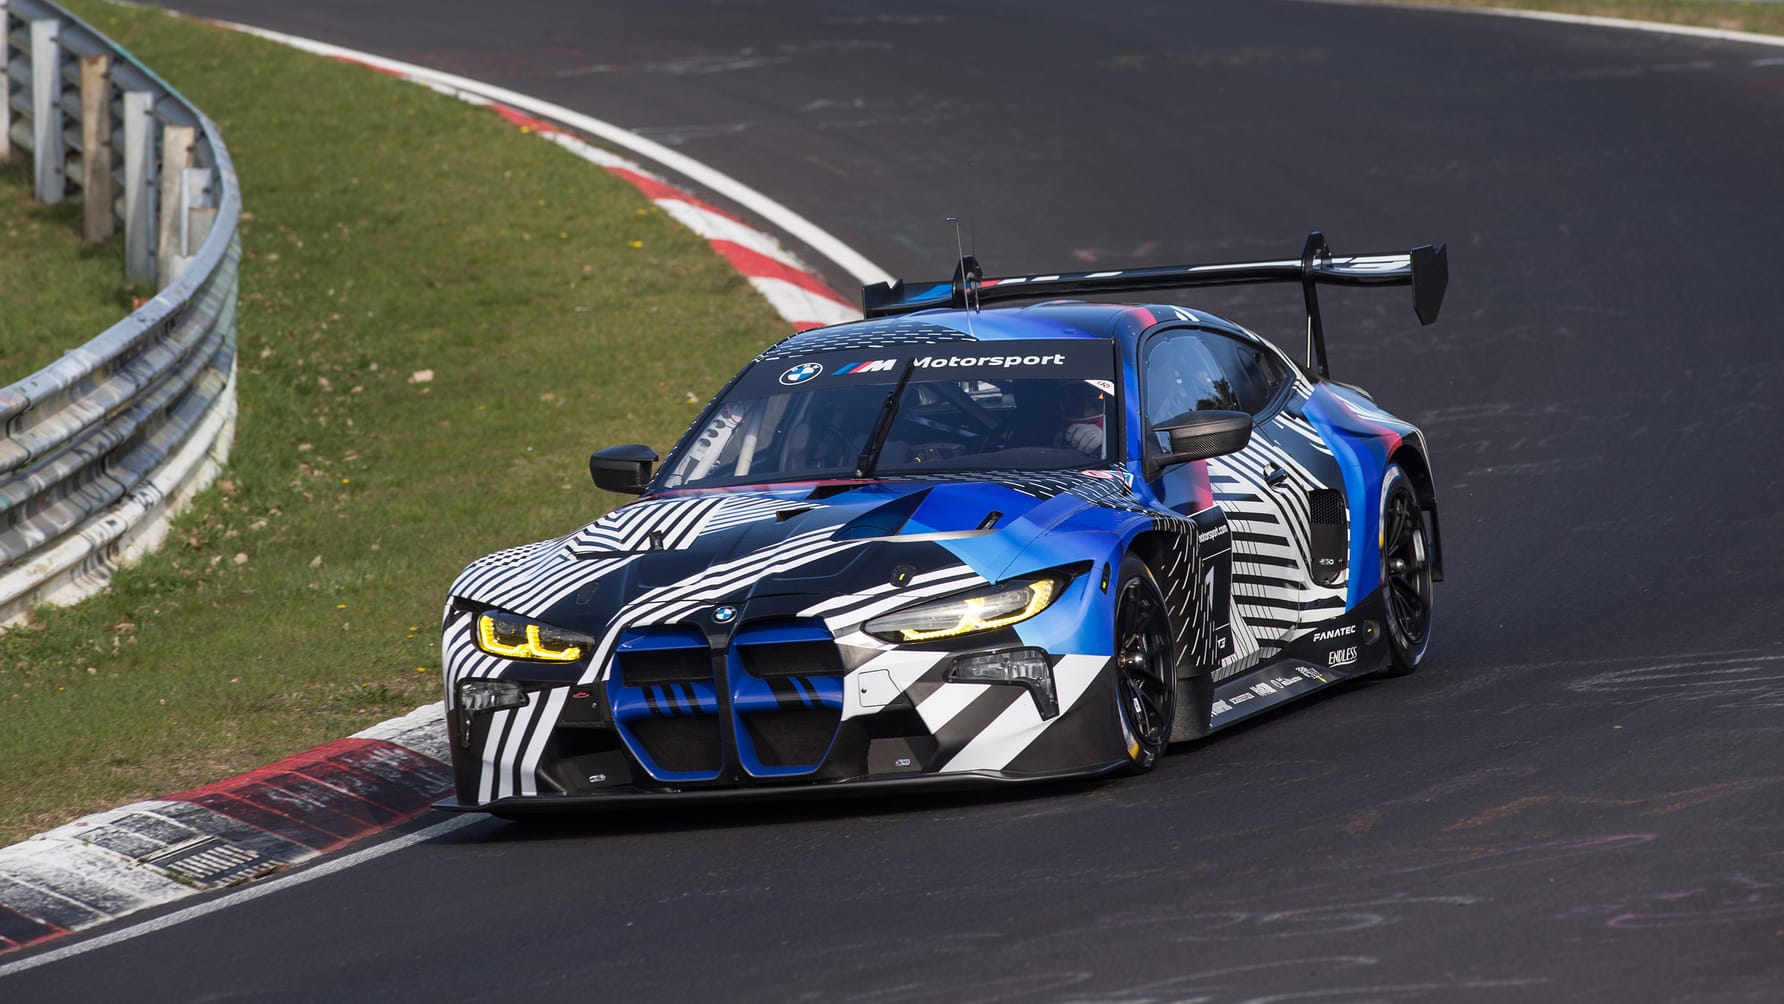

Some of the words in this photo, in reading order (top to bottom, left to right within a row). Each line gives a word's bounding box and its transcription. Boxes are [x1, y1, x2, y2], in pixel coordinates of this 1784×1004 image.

[913, 354, 1066, 368] Motorsport
[1313, 625, 1356, 642] FANATEC
[1328, 645, 1357, 665] ENDLESS
